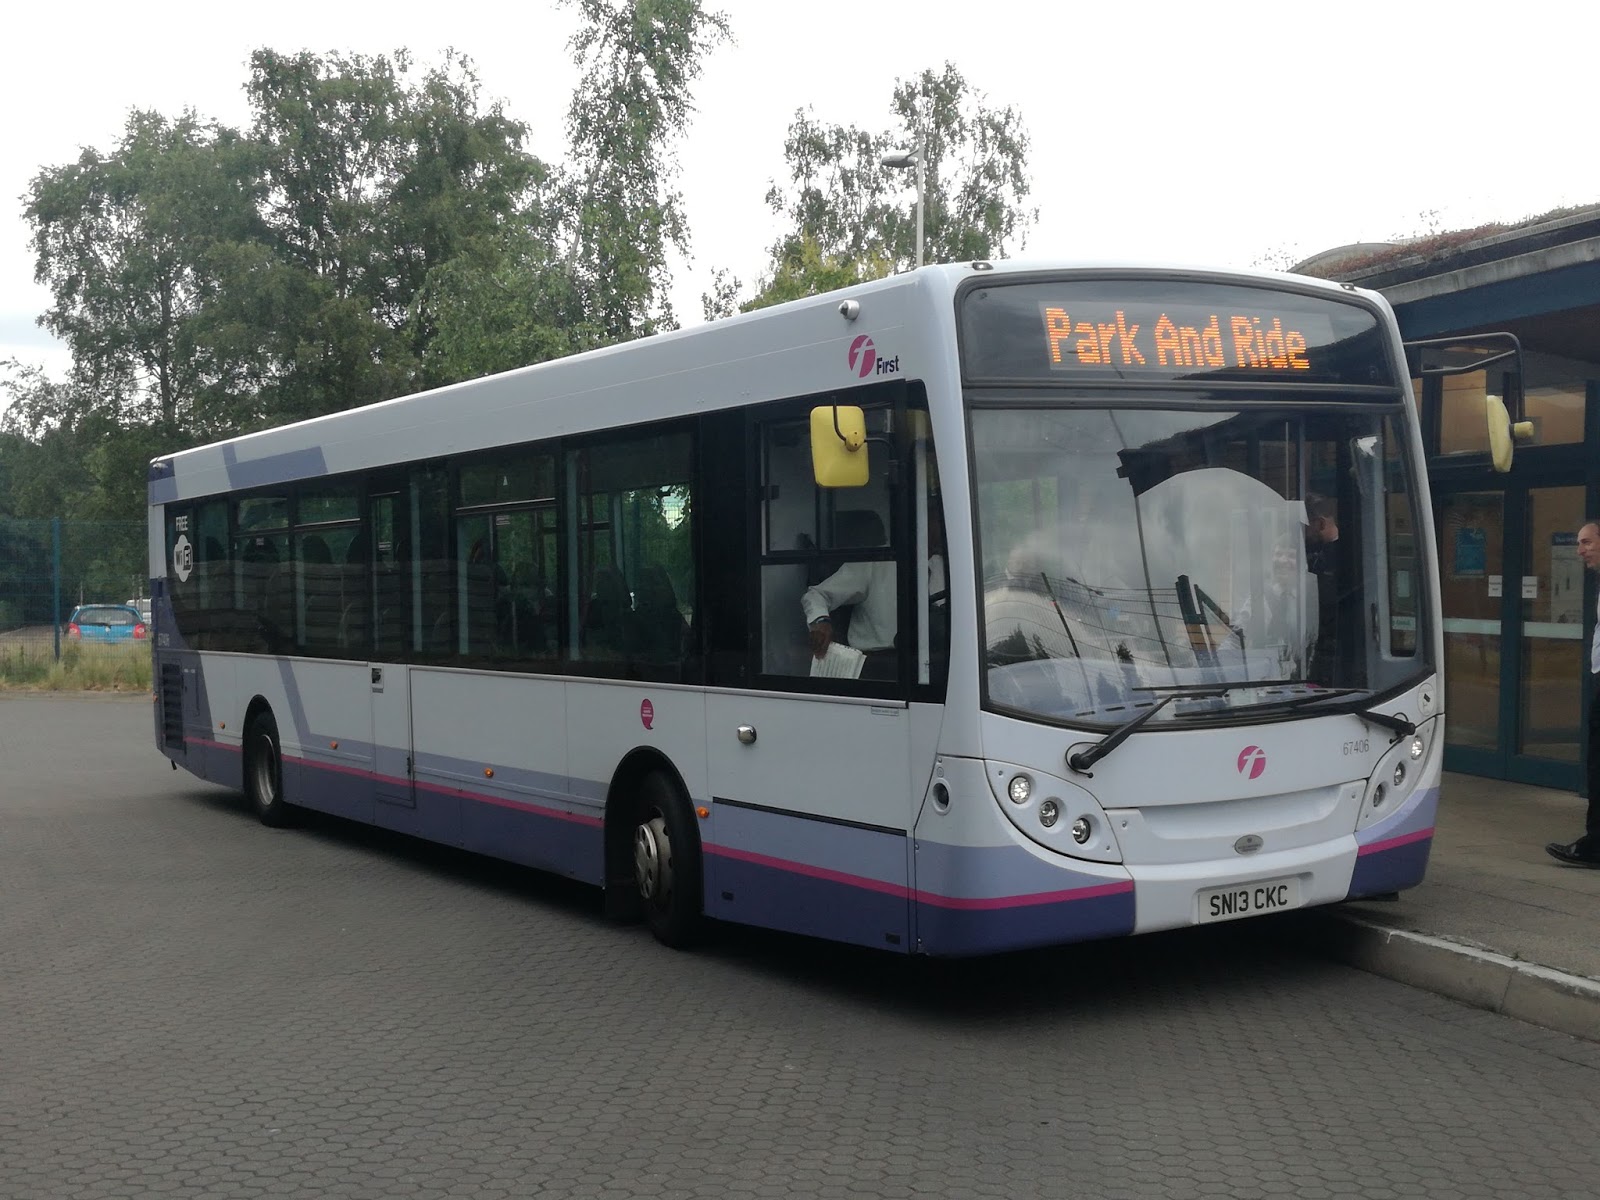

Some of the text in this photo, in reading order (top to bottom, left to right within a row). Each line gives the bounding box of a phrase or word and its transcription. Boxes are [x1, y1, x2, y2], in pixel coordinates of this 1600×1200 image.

[1045, 307, 1311, 370] Park And Ride
[876, 355, 899, 375] First
[175, 515, 188, 531] FREE
[1343, 739, 1369, 755] 67406
[1210, 885, 1288, 916] SN13 CKC
